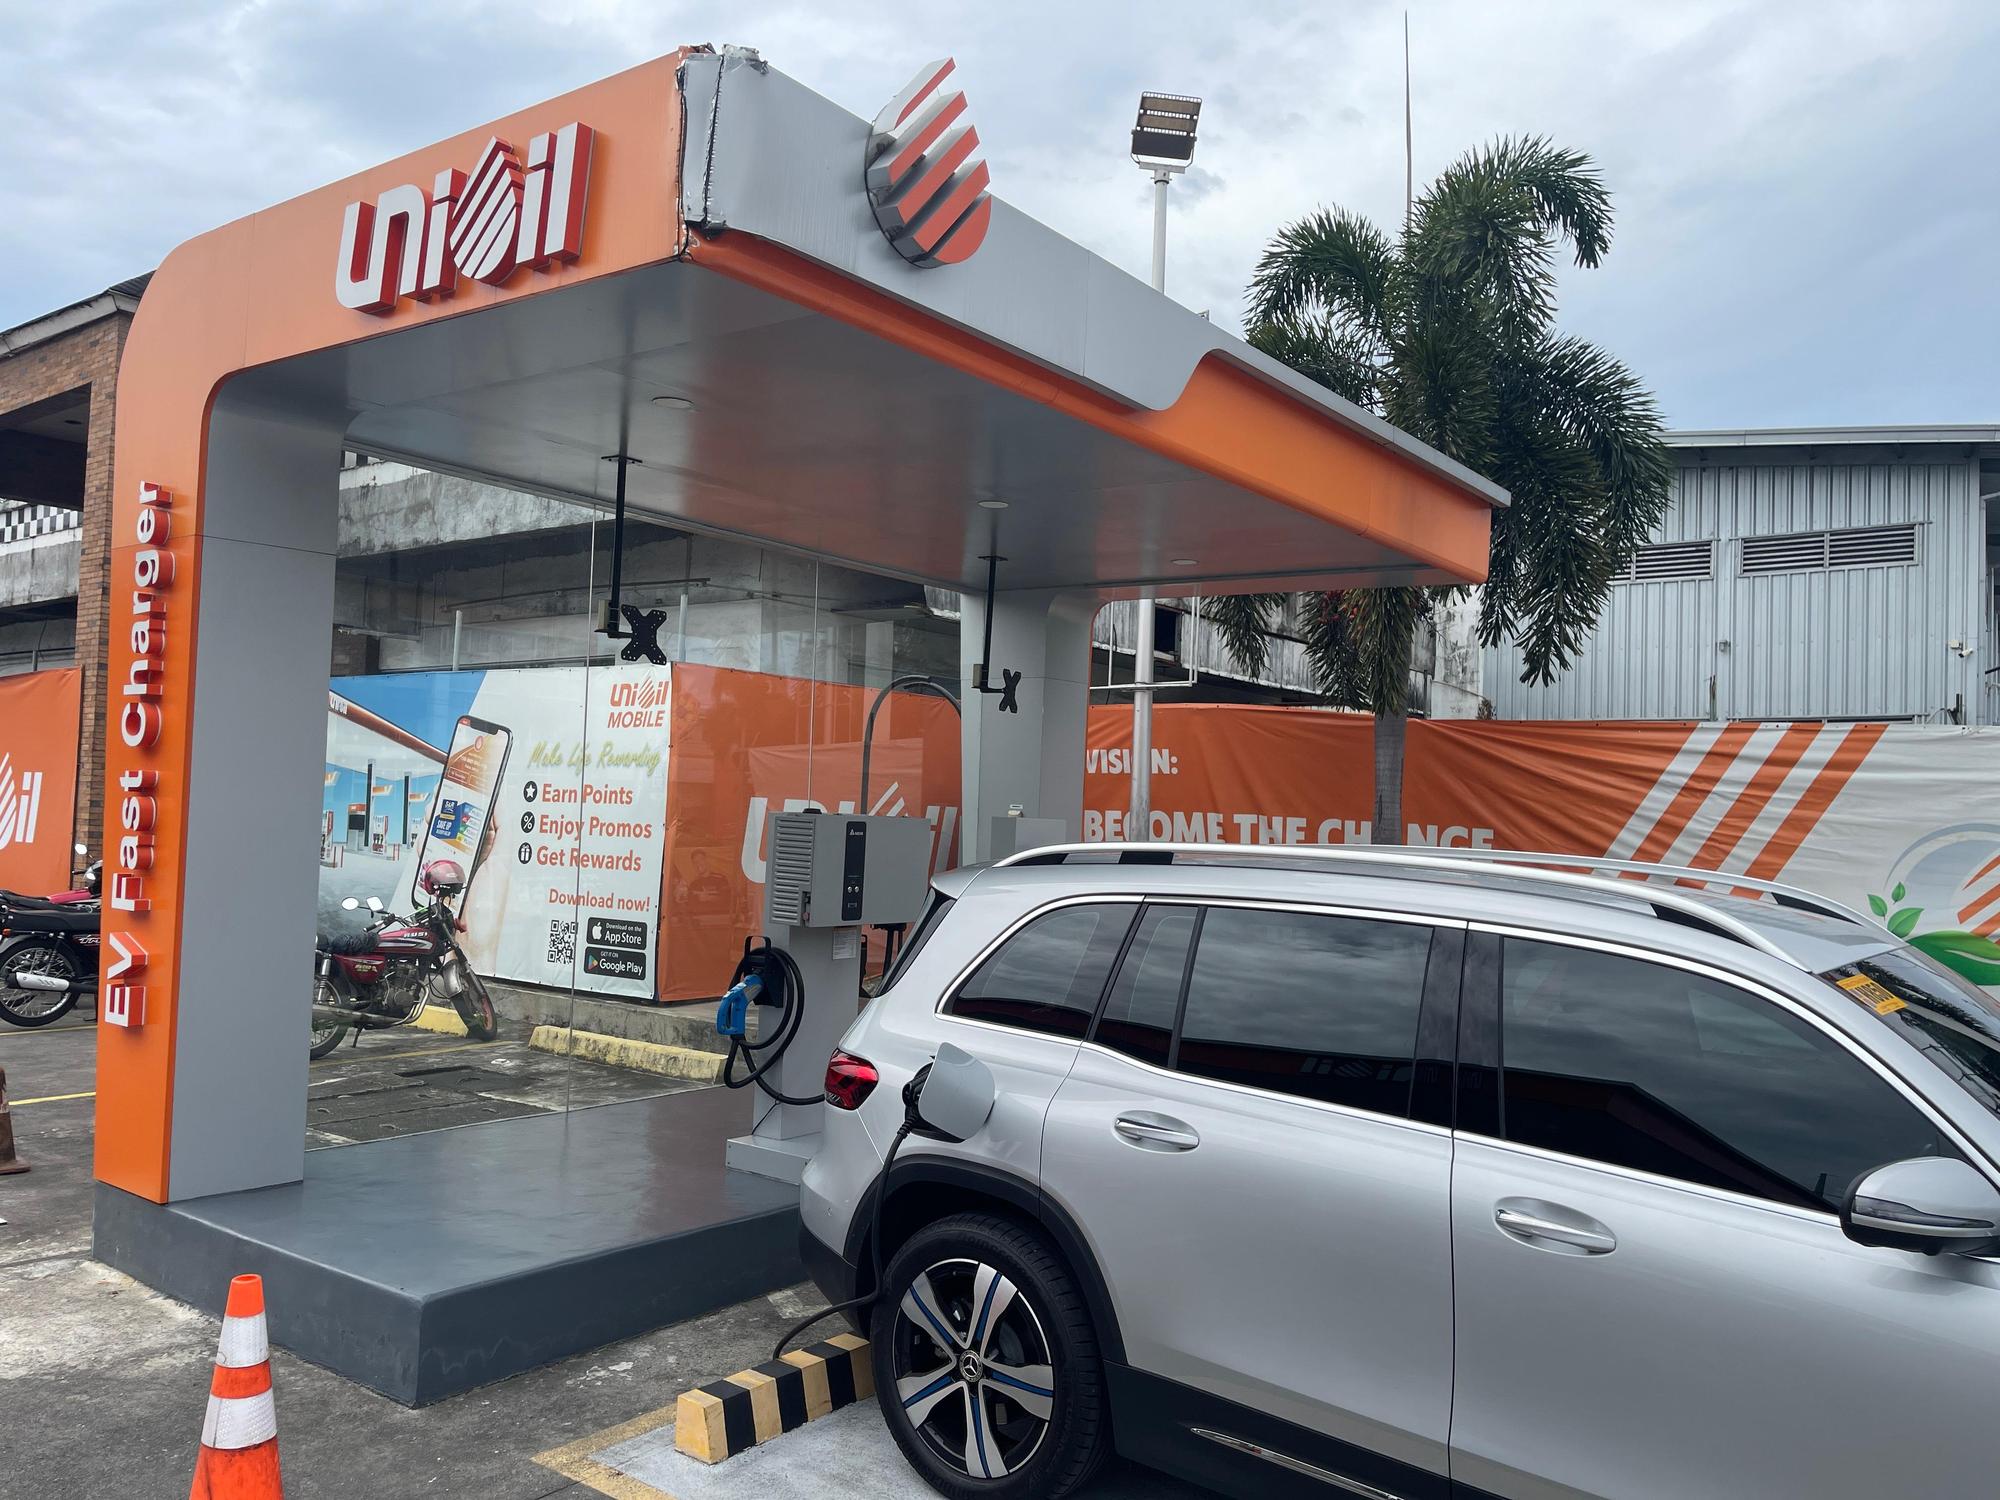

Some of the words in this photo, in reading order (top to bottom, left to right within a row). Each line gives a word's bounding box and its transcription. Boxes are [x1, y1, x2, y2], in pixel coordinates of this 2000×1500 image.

[121, 480, 170, 747] Charger
[607, 710, 666, 729] MOBILE
[1086, 748, 1179, 775] VISIN:
[542, 783, 578, 802] Earn
[582, 784, 634, 805] Points
[111, 770, 154, 912] Fast
[539, 814, 585, 841] Enjoy
[589, 816, 653, 839] Promos
[1084, 809, 1226, 844] BEOME
[1233, 813, 1307, 846] THE
[1317, 817, 1495, 850] CHNGE
[536, 845, 566, 867] Get
[569, 847, 642, 872] Rewards
[548, 888, 615, 909] Download
[617, 896, 651, 912] now!
[604, 930, 621, 945] App
[621, 931, 642, 945] Store
[605, 922, 628, 931] Download
[104, 931, 146, 1028] EV
[599, 958, 626, 974] Google
[626, 961, 643, 976] Play
